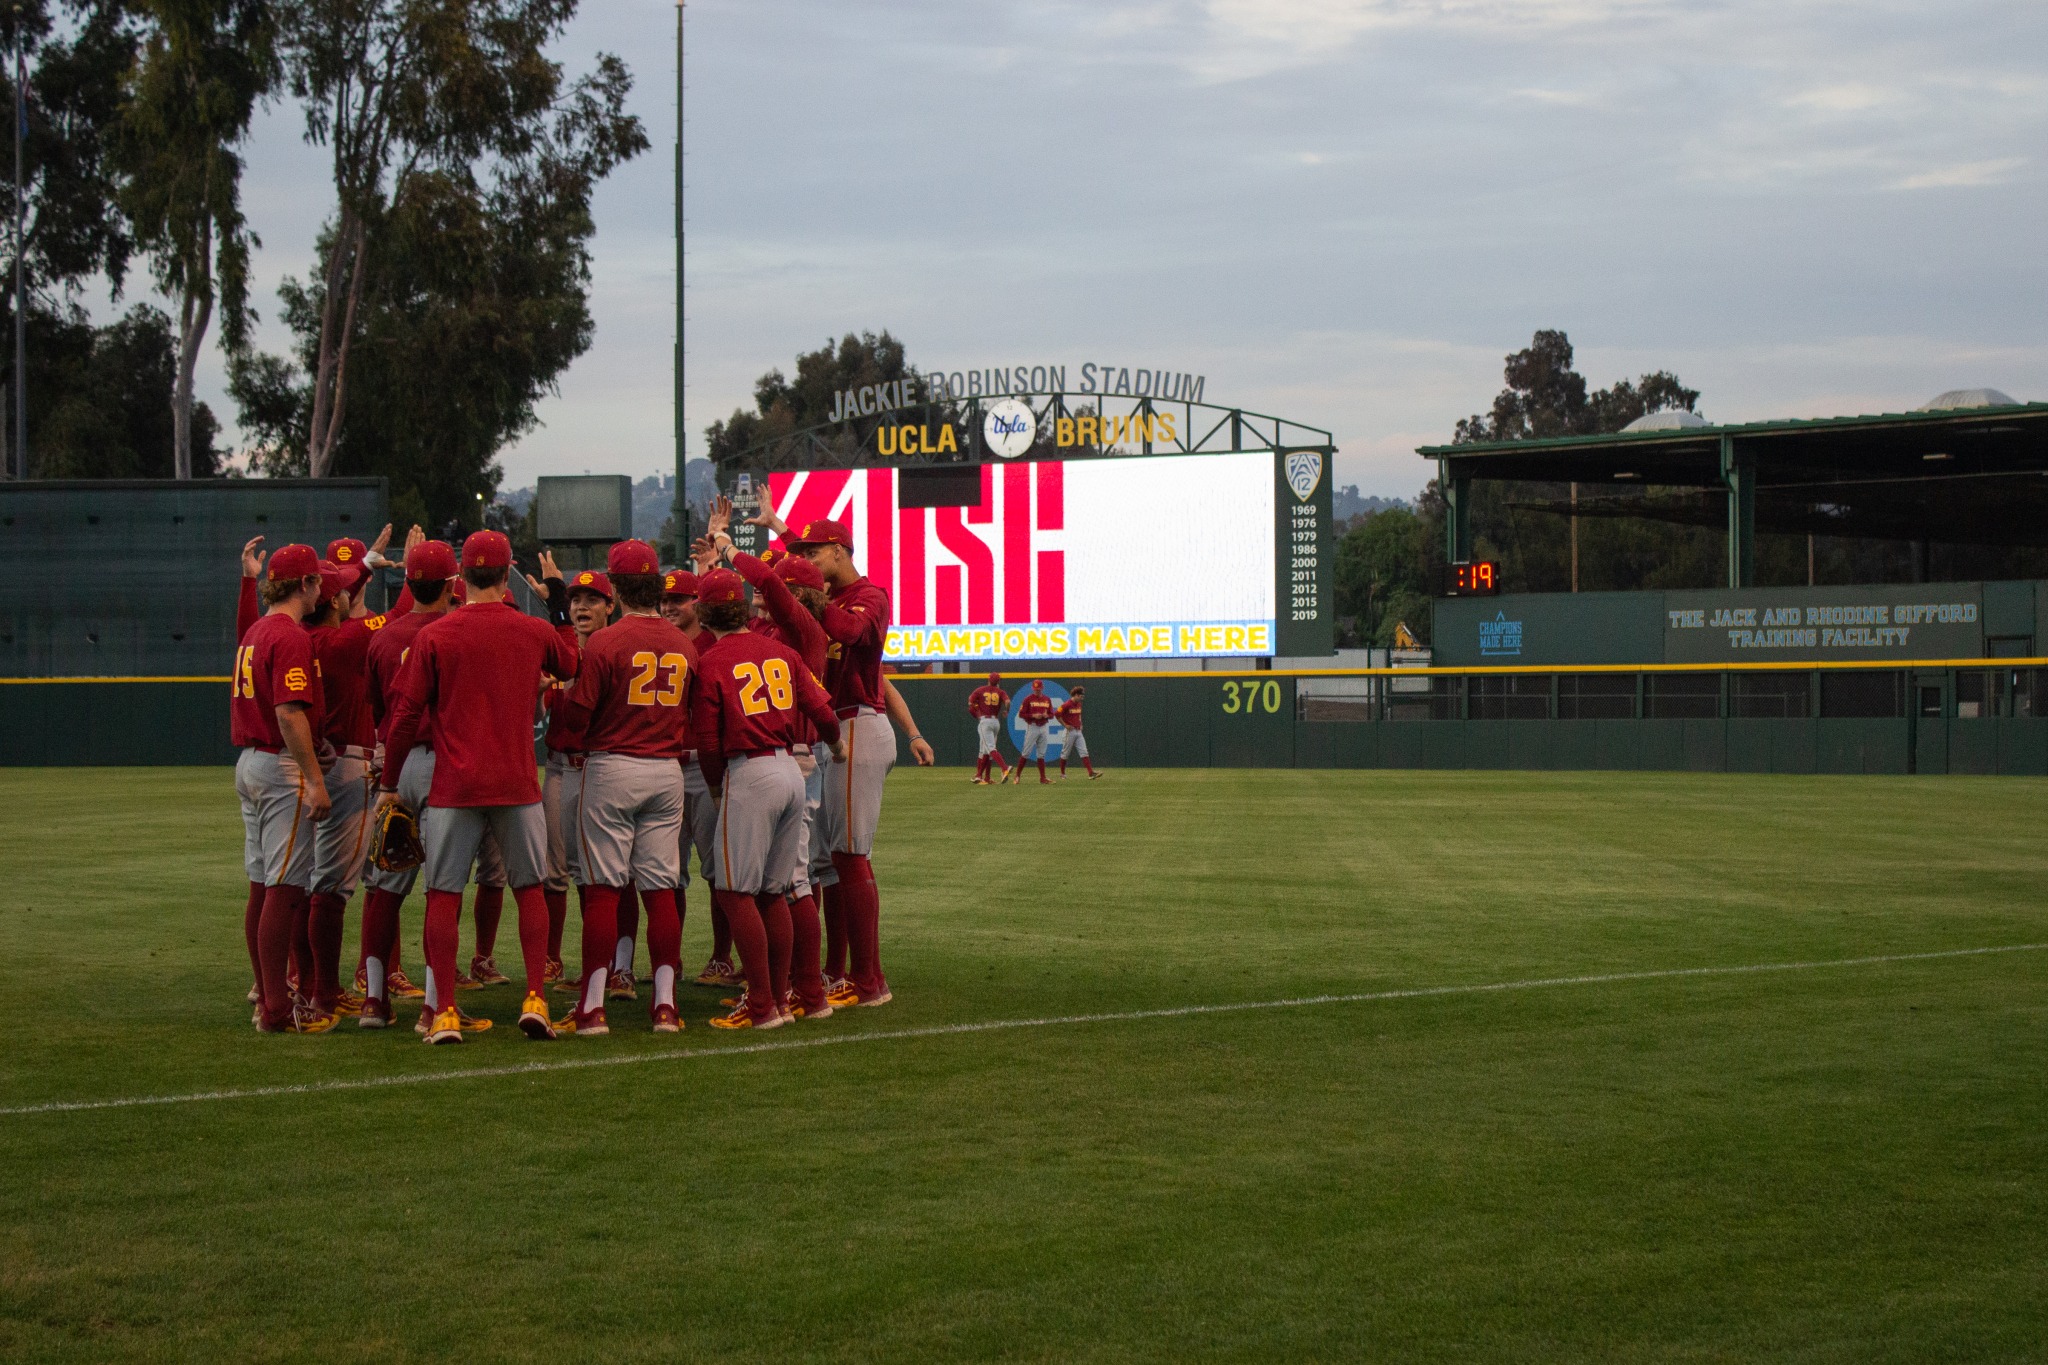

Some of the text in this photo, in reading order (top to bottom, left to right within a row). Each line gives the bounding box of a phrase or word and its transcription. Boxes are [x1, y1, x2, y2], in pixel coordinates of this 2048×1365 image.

[828, 362, 1206, 423] JACKIE ROBINSON STADIUM
[1056, 413, 1176, 447] BRUINS
[877, 423, 958, 455] UCLA
[1292, 506, 1316, 515] 1969
[734, 525, 755, 534] 1969
[1292, 519, 1316, 528] 1976
[734, 537, 755, 547] 1997
[1292, 532, 1316, 542] 1979
[1292, 545, 1316, 554] 1986
[1292, 558, 1316, 568] 2000
[1292, 572, 1316, 581] 2011
[1292, 584, 1317, 594] 2012
[1292, 598, 1317, 607] 2015
[1292, 611, 1317, 620] 2019
[1669, 604, 1978, 628] THE JACK AND RHODINE GIFFORD
[1480, 621, 1522, 635] CHAMPIONS
[883, 625, 1268, 655] CHAMPIONS MADE HERE
[1480, 634, 1522, 648] MADE HERE
[1728, 627, 1909, 648] TRAINING FACILITY
[233, 645, 255, 699] 15
[627, 651, 688, 706] 23
[732, 657, 794, 716] 28
[983, 692, 1000, 705] 39
[1222, 680, 1281, 713] 370
